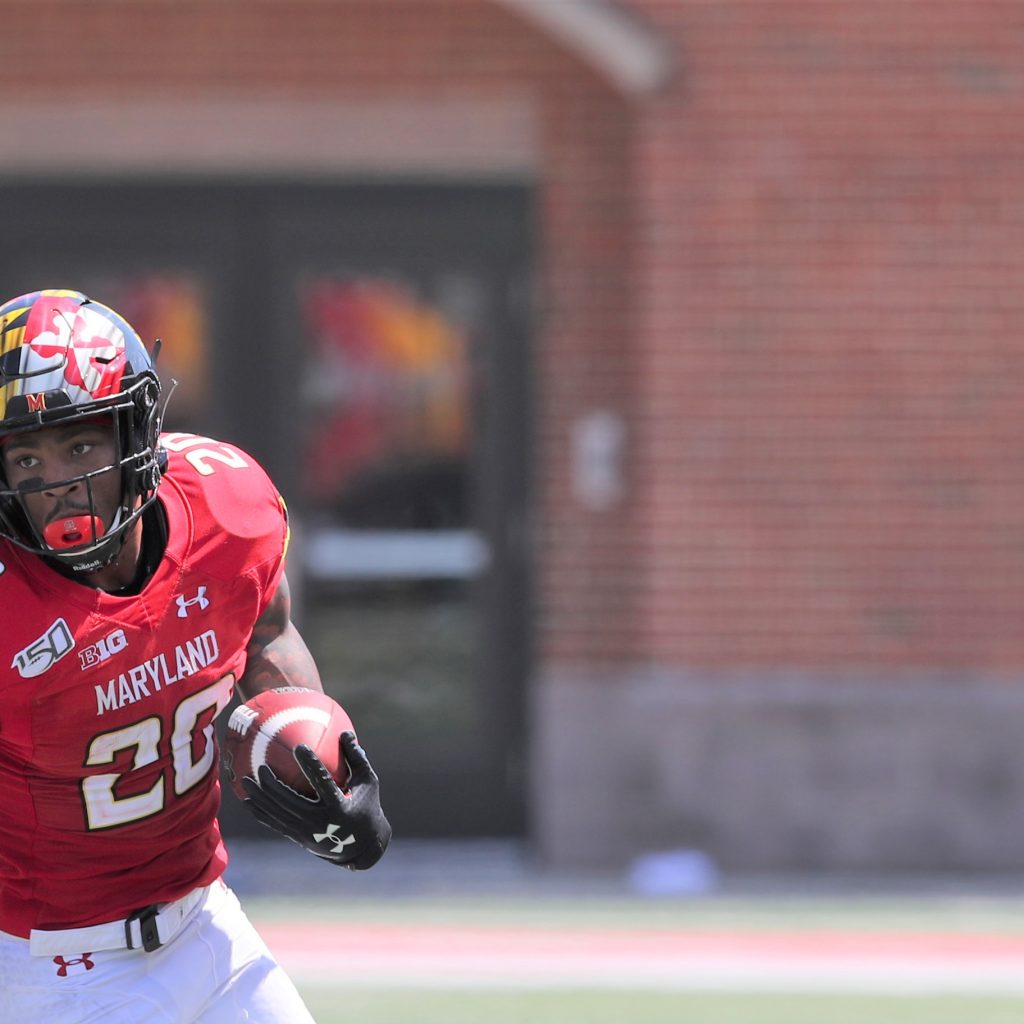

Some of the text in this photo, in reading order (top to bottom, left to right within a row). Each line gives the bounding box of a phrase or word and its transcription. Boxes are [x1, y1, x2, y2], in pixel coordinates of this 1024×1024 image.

[13, 618, 74, 675] 150
[94, 630, 219, 716] MARYLAND
[82, 672, 236, 832] 20
